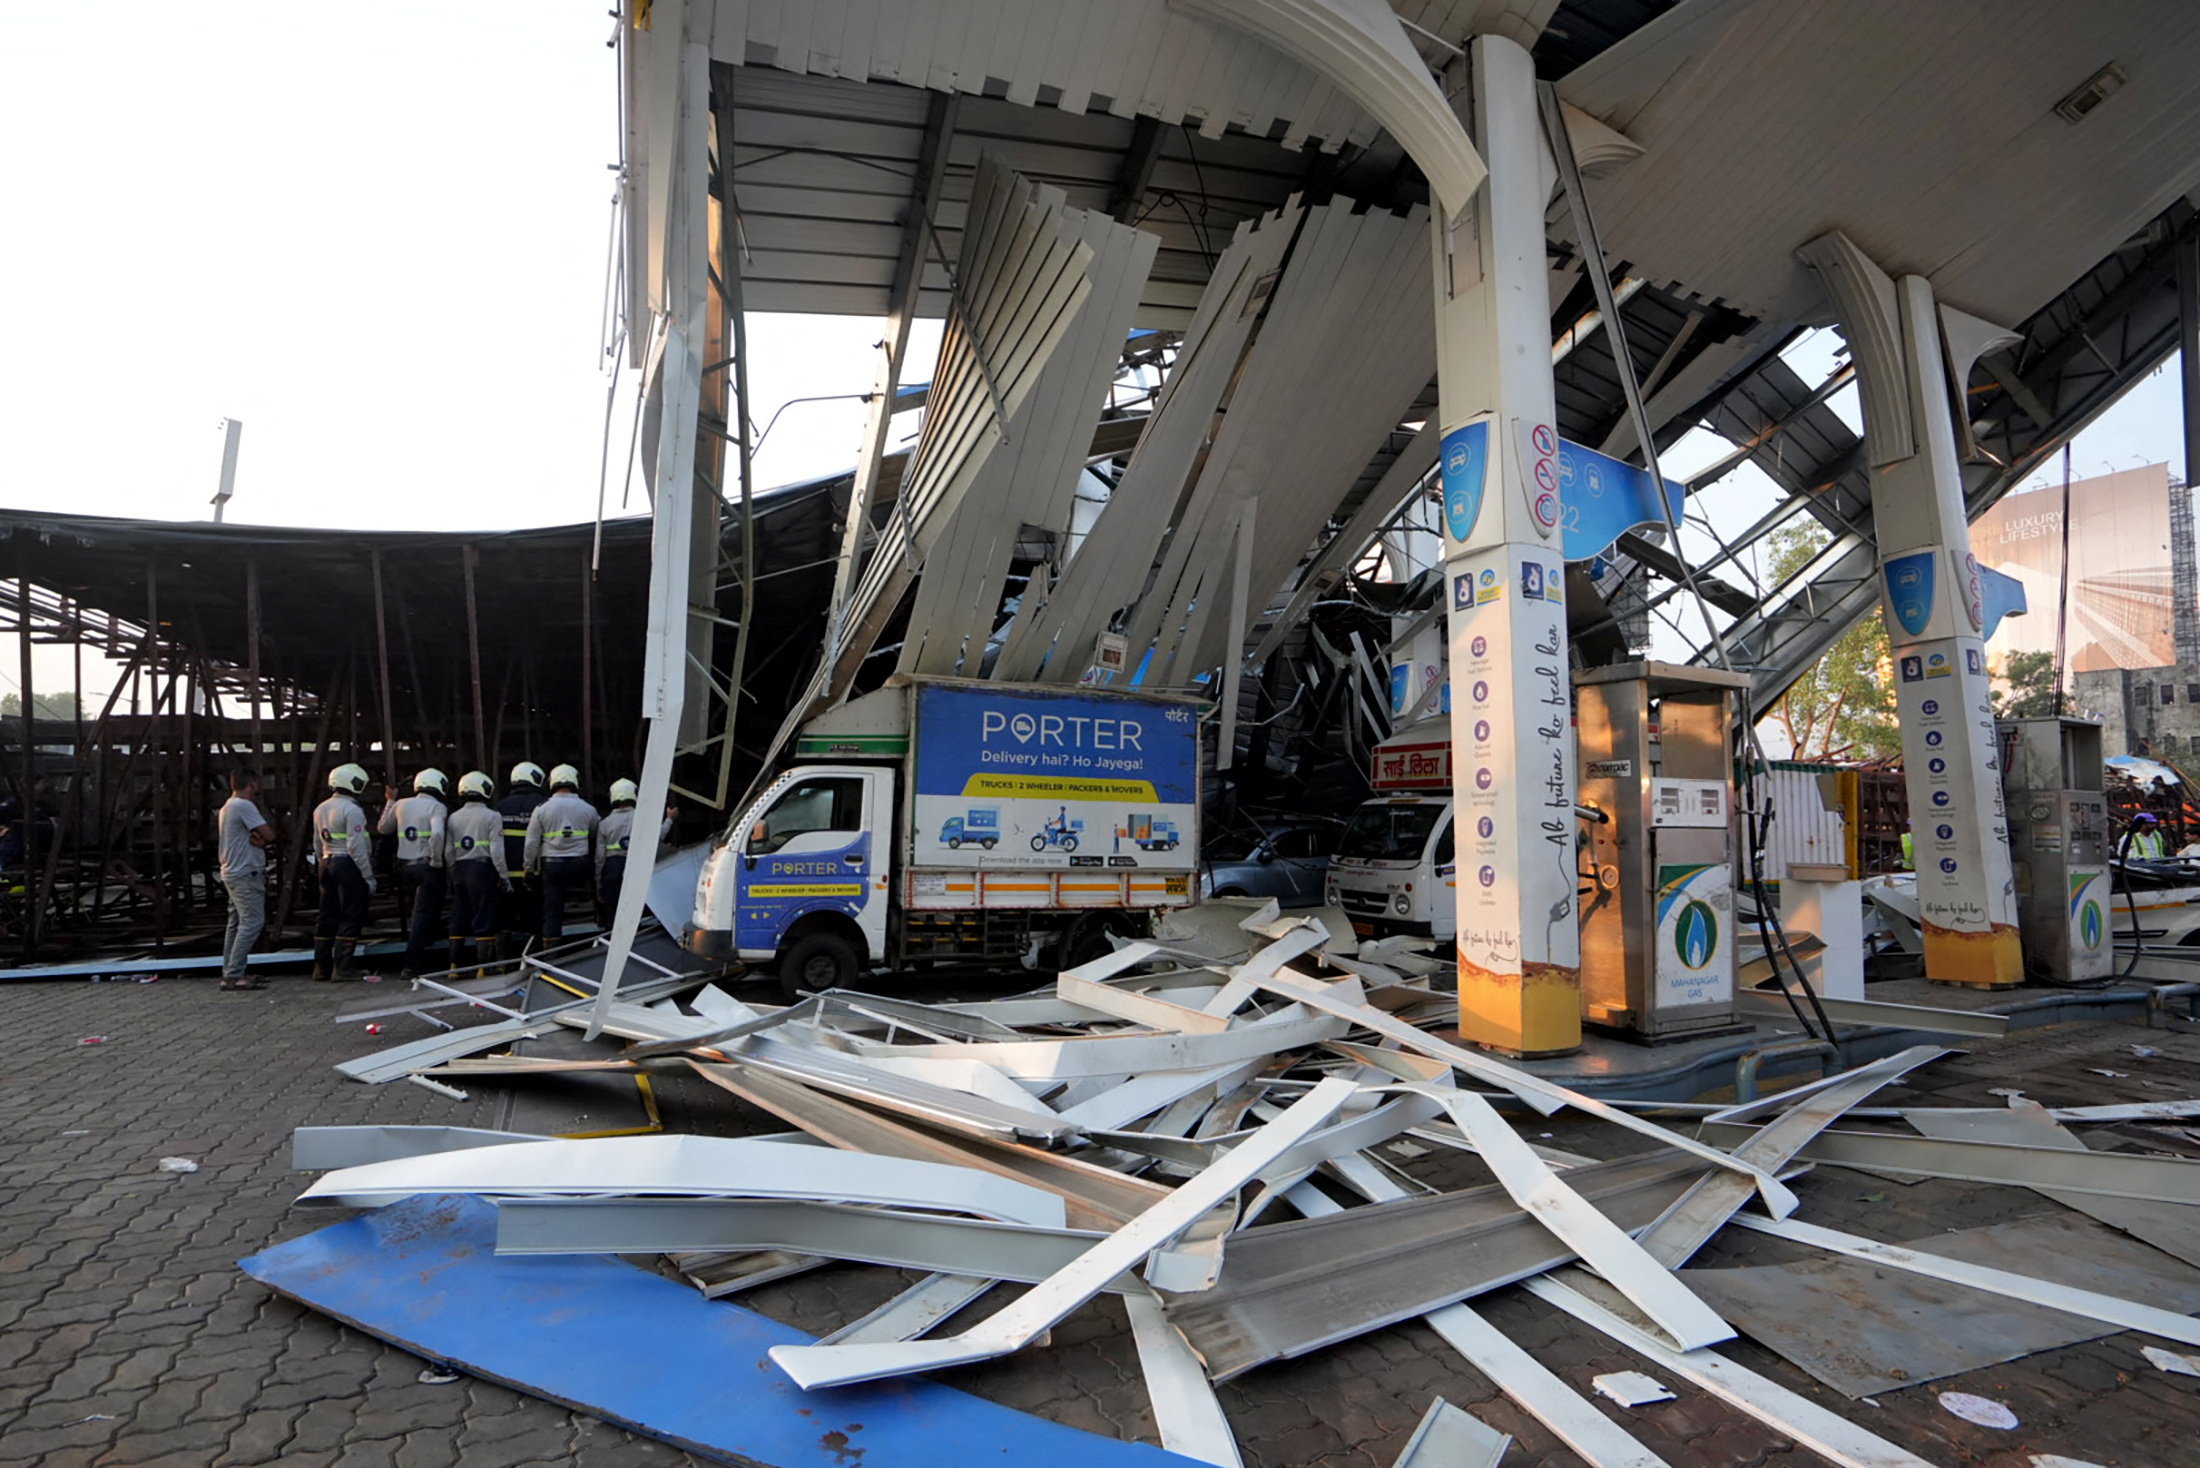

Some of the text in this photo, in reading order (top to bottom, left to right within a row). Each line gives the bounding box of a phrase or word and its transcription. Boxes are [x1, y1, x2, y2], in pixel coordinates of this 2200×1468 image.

[2005, 510, 2064, 532] LUXURY
[1535, 666, 1566, 706] feel
[982, 711, 1143, 751] PORTER
[981, 750, 1143, 771] Delivery hai? Ho Jayega!
[981, 780, 1013, 789] TRUCKS
[1026, 782, 1063, 790] WHEELER
[1069, 784, 1103, 792] PACKERS
[1112, 786, 1144, 794] MOVERS
[773, 862, 837, 875] PORTER
[1671, 975, 1719, 987] MAHANAGAR
[1688, 988, 1703, 998] GAS
